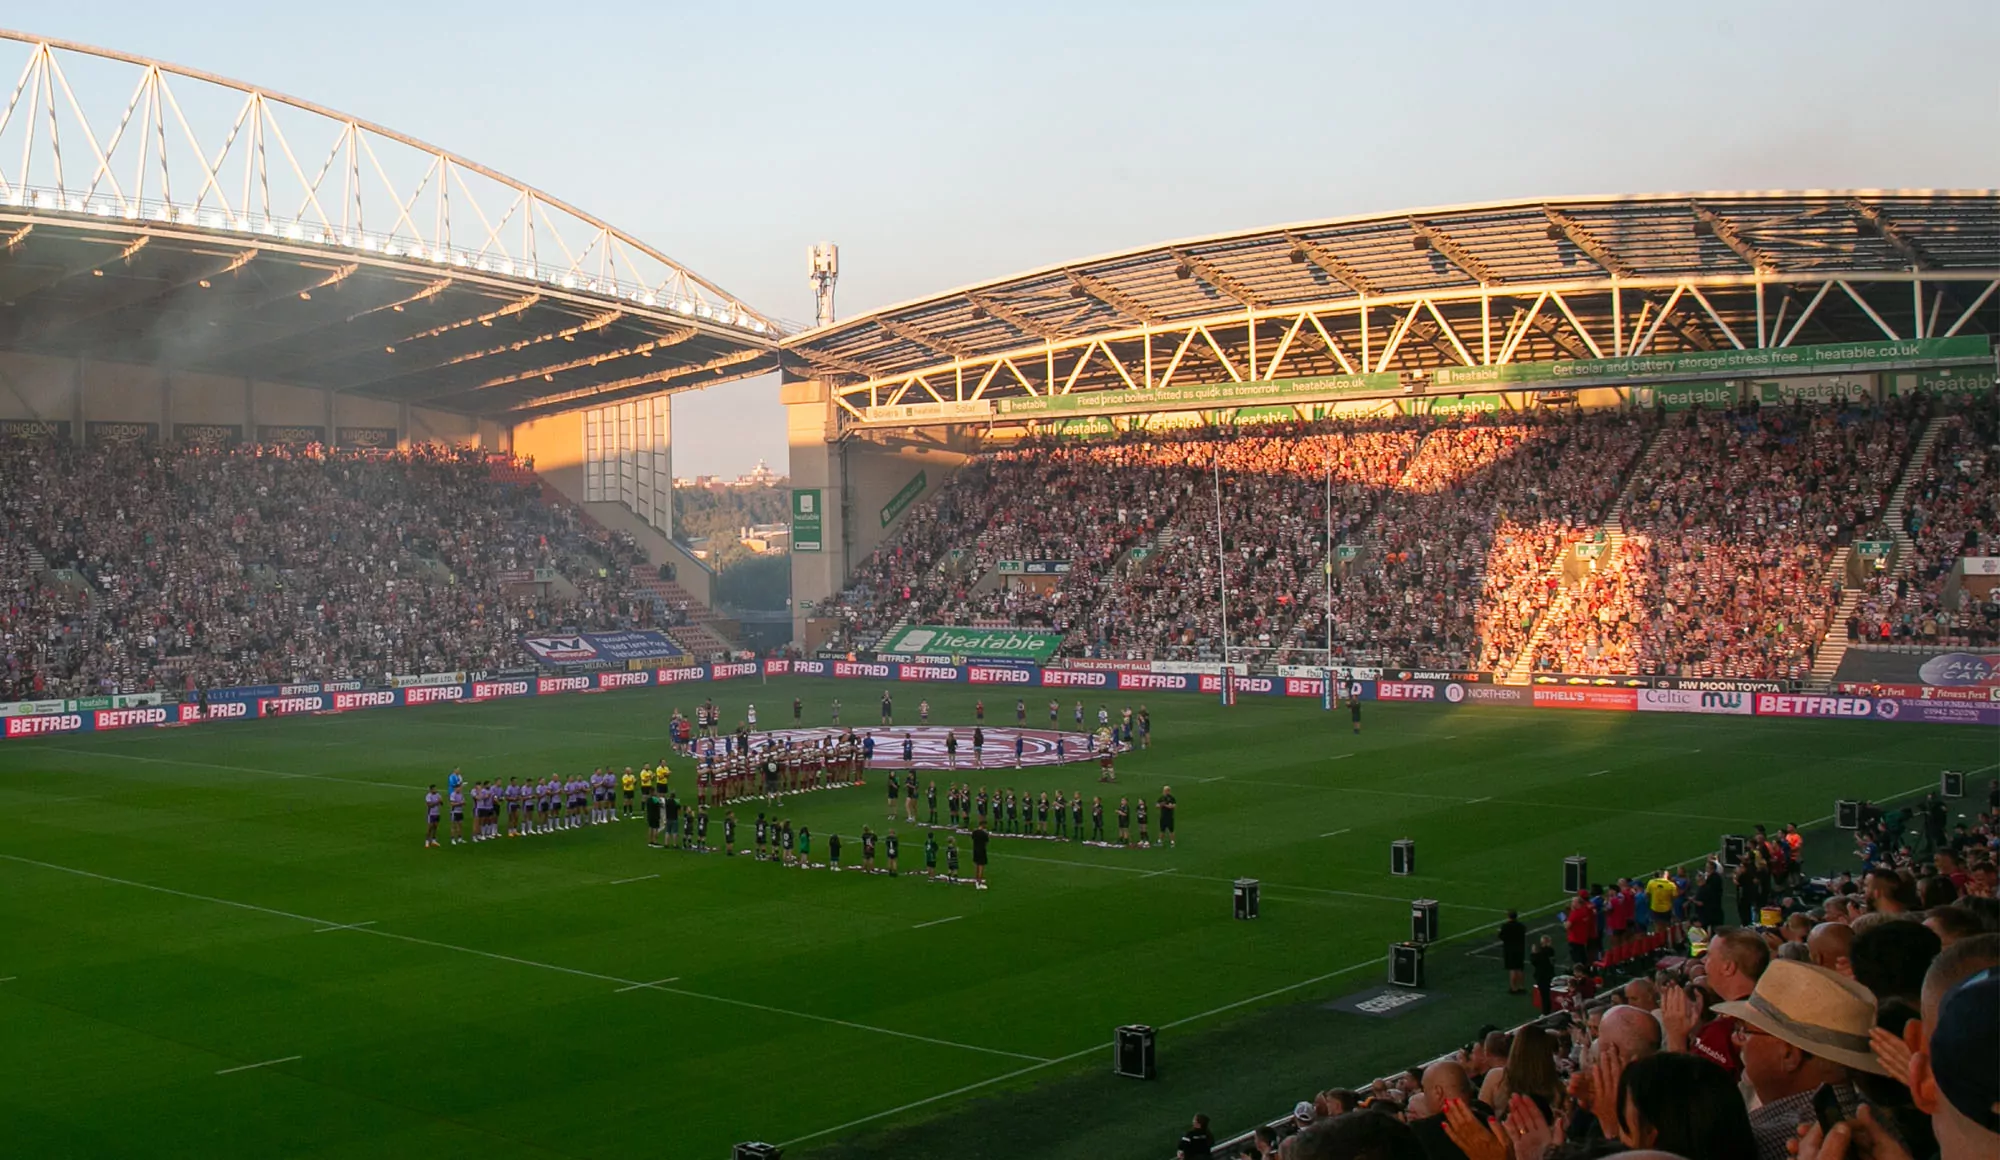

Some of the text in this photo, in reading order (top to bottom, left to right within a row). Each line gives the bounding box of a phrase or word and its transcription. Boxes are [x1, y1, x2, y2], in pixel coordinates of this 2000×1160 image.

[1553, 365, 1573, 376] Get
[1576, 362, 1603, 374] solar
[1607, 361, 1629, 373] and
[1631, 358, 1675, 373] battery
[1679, 356, 1726, 370] storage
[1728, 353, 1769, 365] stress
[1771, 351, 1798, 363] free
[1815, 343, 1920, 361] heatable.co.uk
[1452, 369, 1498, 382] heatable
[1077, 395, 1100, 406] Fixed
[1101, 392, 1123, 406] price
[1157, 388, 1181, 400] fitted
[1183, 391, 1194, 399] as
[1196, 387, 1221, 400] quick
[1222, 388, 1234, 397] as
[1235, 384, 1280, 395] tomorrow
[1292, 377, 1365, 392] heatable.co.uk
[1658, 384, 1731, 405] heatable
[1785, 381, 1863, 399] heatable
[955, 403, 976, 414] Solar
[1012, 399, 1048, 410] heatable
[342, 429, 388, 441] KINGDOM
[935, 631, 1046, 651] heatable
[714, 662, 757, 677] BETFRED
[836, 663, 888, 677] BETFRED
[902, 666, 957, 679] BETFRED
[1131, 663, 1151, 671] BALLS
[1948, 661, 1984, 670] ALL
[470, 671, 488, 682] TAP
[601, 672, 649, 687] BETFRED
[659, 667, 704, 682] BETFRED
[971, 669, 1029, 682] BETFRED
[1044, 671, 1106, 685] BETFRED
[1121, 674, 1186, 688] BETFRED
[281, 684, 319, 695] BETFRED
[324, 681, 361, 692] BETFRED
[475, 682, 527, 697] BETFRED
[539, 677, 589, 691] BETFRED
[1202, 677, 1272, 692] BEFRED
[1380, 683, 1435, 698] BETFR
[1679, 681, 1698, 690] HW
[1700, 682, 1735, 691] MOON
[337, 691, 394, 707] BETFRED
[408, 686, 463, 702] BETFRED
[1468, 688, 1520, 699] NORTHERN
[1534, 690, 1585, 702] BITHELL'S
[1646, 689, 1690, 704] Celtic
[1759, 697, 1871, 716] BETFRED
[100, 708, 166, 726] BETFRED
[10, 715, 81, 734] BETFRED
